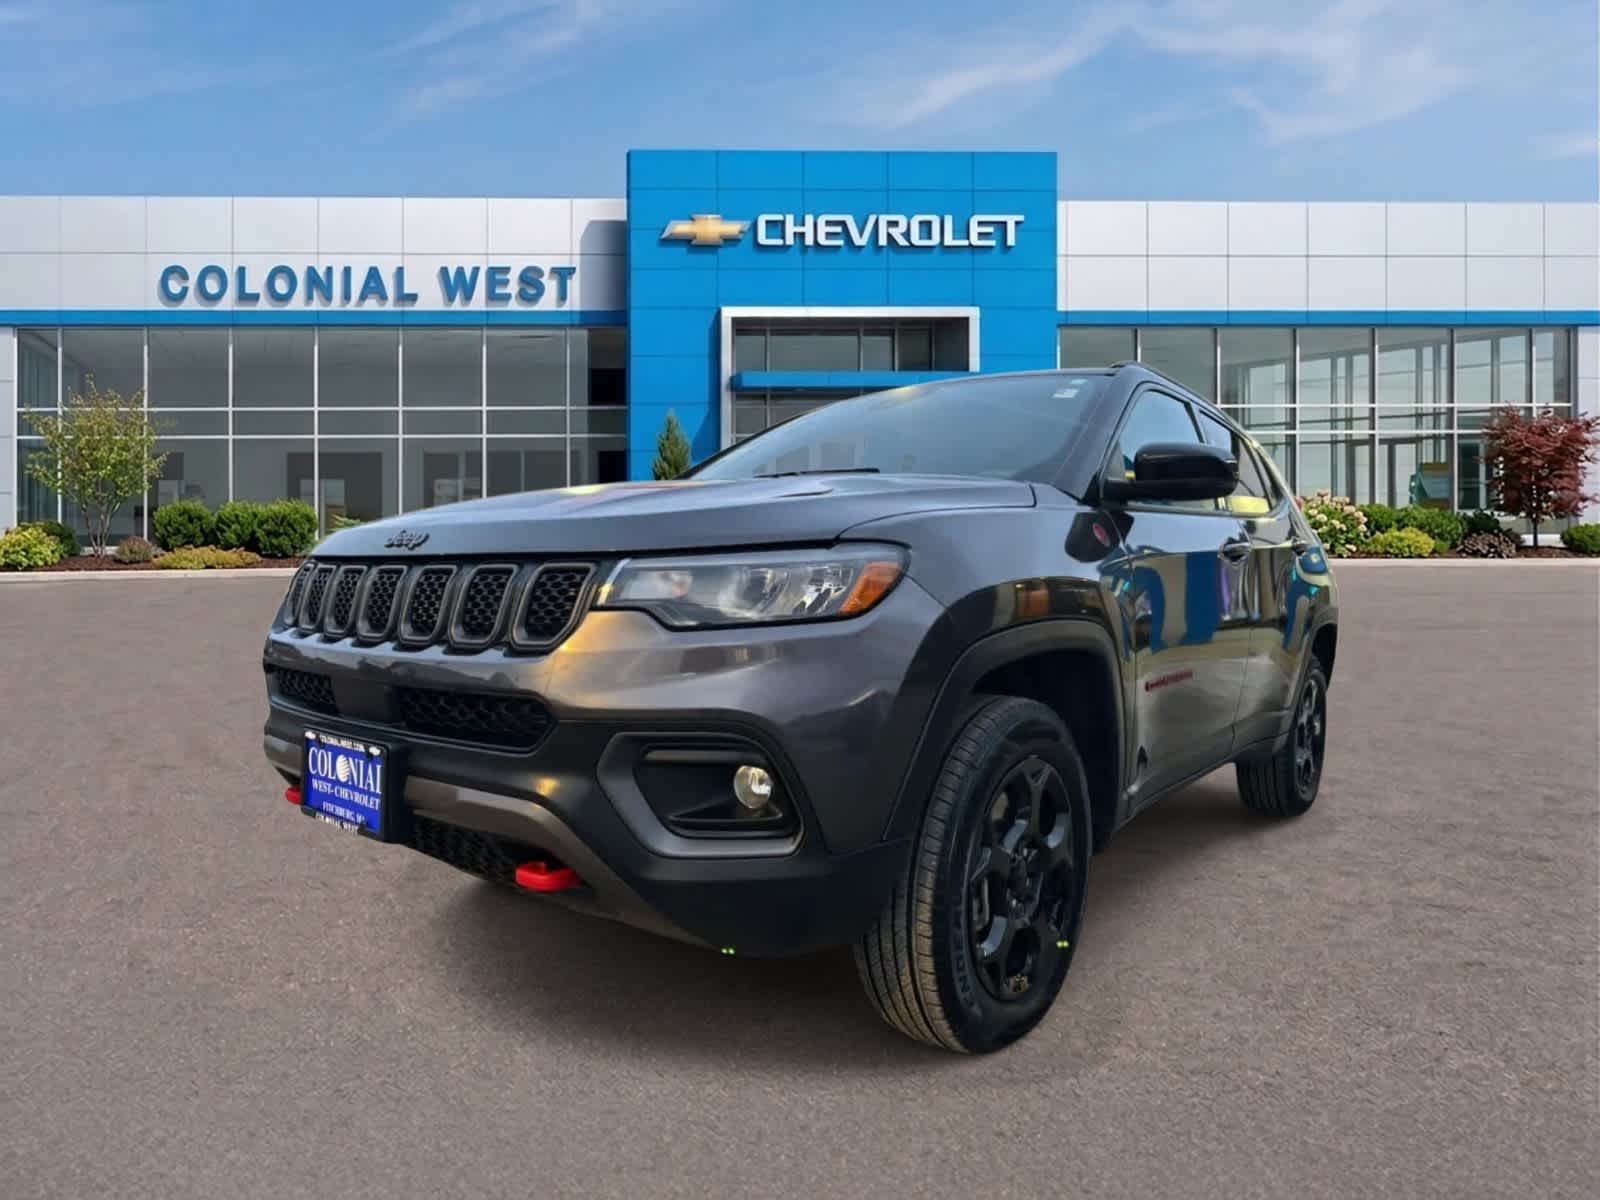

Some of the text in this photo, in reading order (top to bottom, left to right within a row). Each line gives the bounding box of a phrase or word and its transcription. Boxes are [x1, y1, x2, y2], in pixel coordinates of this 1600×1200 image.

[757, 213, 1024, 247] CHEVROLET
[160, 265, 577, 305] COLONIAL WEST
[384, 529, 430, 551] Jeep
[308, 746, 383, 794] COLONIAL
